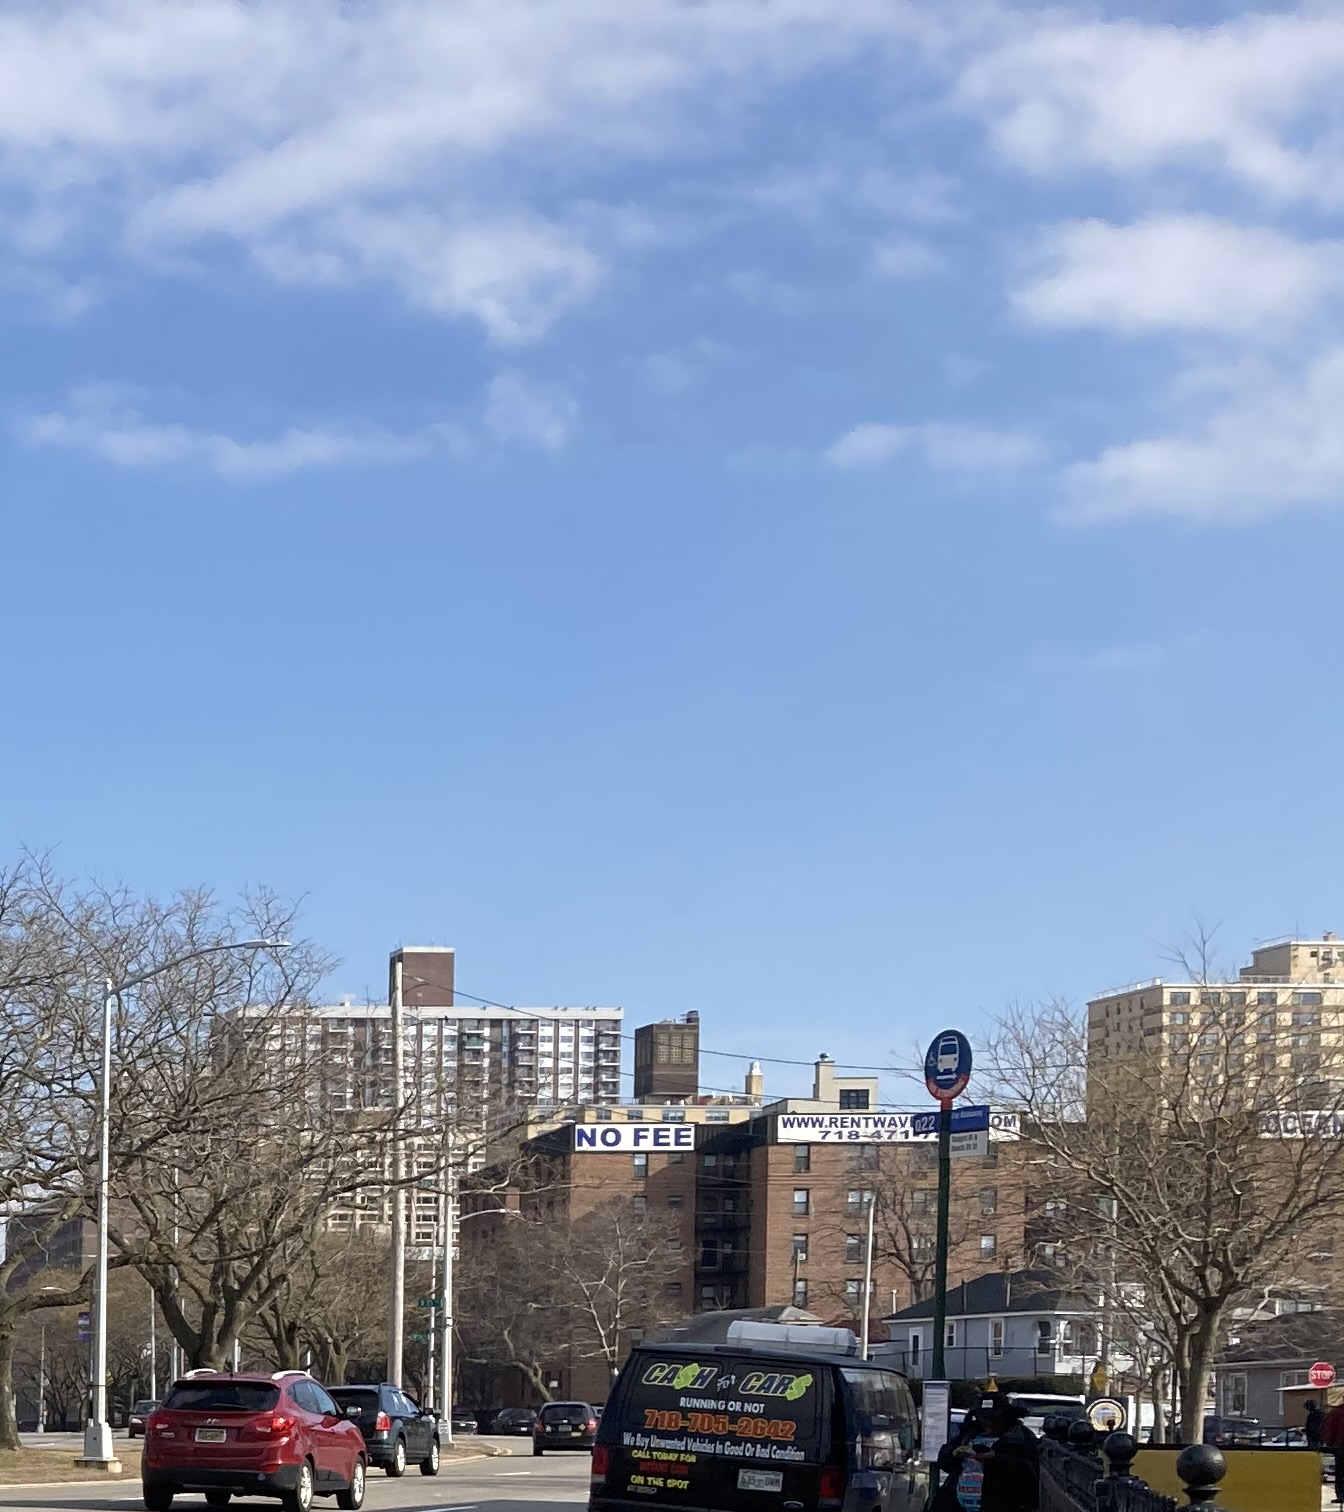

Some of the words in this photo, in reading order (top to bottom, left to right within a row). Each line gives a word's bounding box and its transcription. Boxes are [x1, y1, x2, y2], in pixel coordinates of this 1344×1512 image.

[914, 1115, 936, 1132] Q22
[576, 1127, 622, 1147] NO
[633, 1127, 692, 1147] FEE
[818, 1129, 939, 1140] 718-471-
[1311, 1369, 1334, 1380] STOP
[679, 1396, 726, 1411] RUNNING
[727, 1400, 742, 1412] OR
[743, 1402, 766, 1413] NOT
[644, 1409, 797, 1441] 718-705-2642
[623, 1431, 635, 1446] We
[635, 1433, 650, 1451] Buy
[651, 1434, 686, 1451] Unwanted
[724, 1441, 744, 1456] Good
[745, 1442, 755, 1457] Or
[755, 1443, 771, 1458] Bad
[772, 1445, 805, 1461] Condition
[632, 1449, 651, 1459] CALL
[630, 1474, 645, 1485] ON
[646, 1476, 664, 1487] THE
[666, 1478, 690, 1490] SPOT
